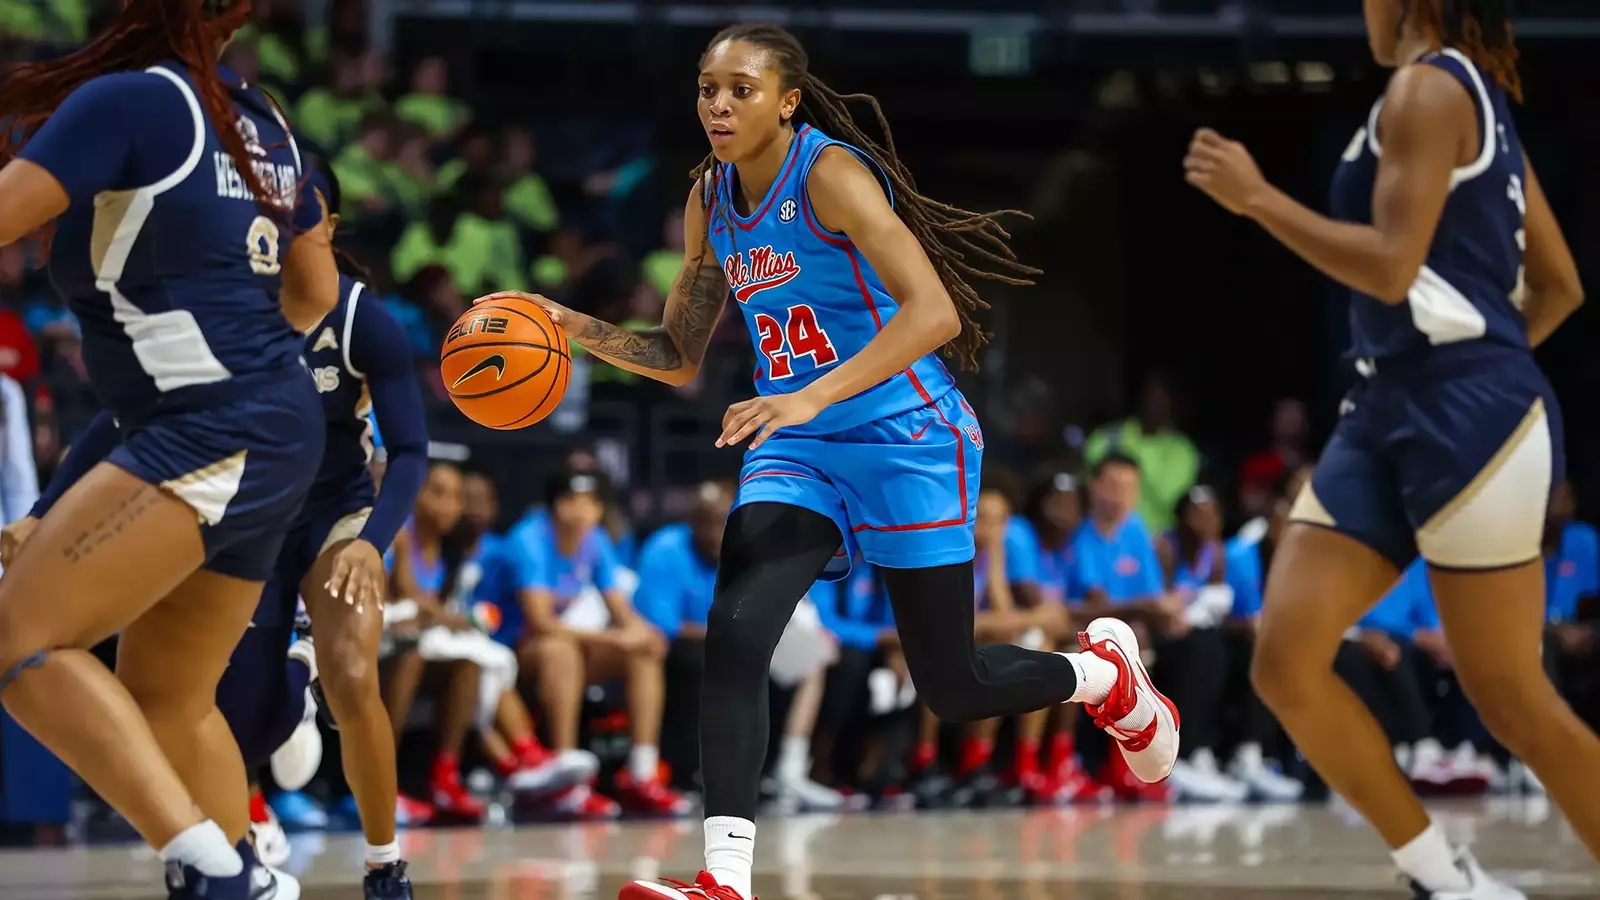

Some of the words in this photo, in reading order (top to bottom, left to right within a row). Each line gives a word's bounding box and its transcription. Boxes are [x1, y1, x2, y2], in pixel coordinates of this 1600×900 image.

[780, 199, 797, 221] SEC
[724, 252, 750, 289] Ole
[749, 244, 798, 283] Miss
[448, 318, 508, 344] ELITE
[754, 304, 839, 380] 24
